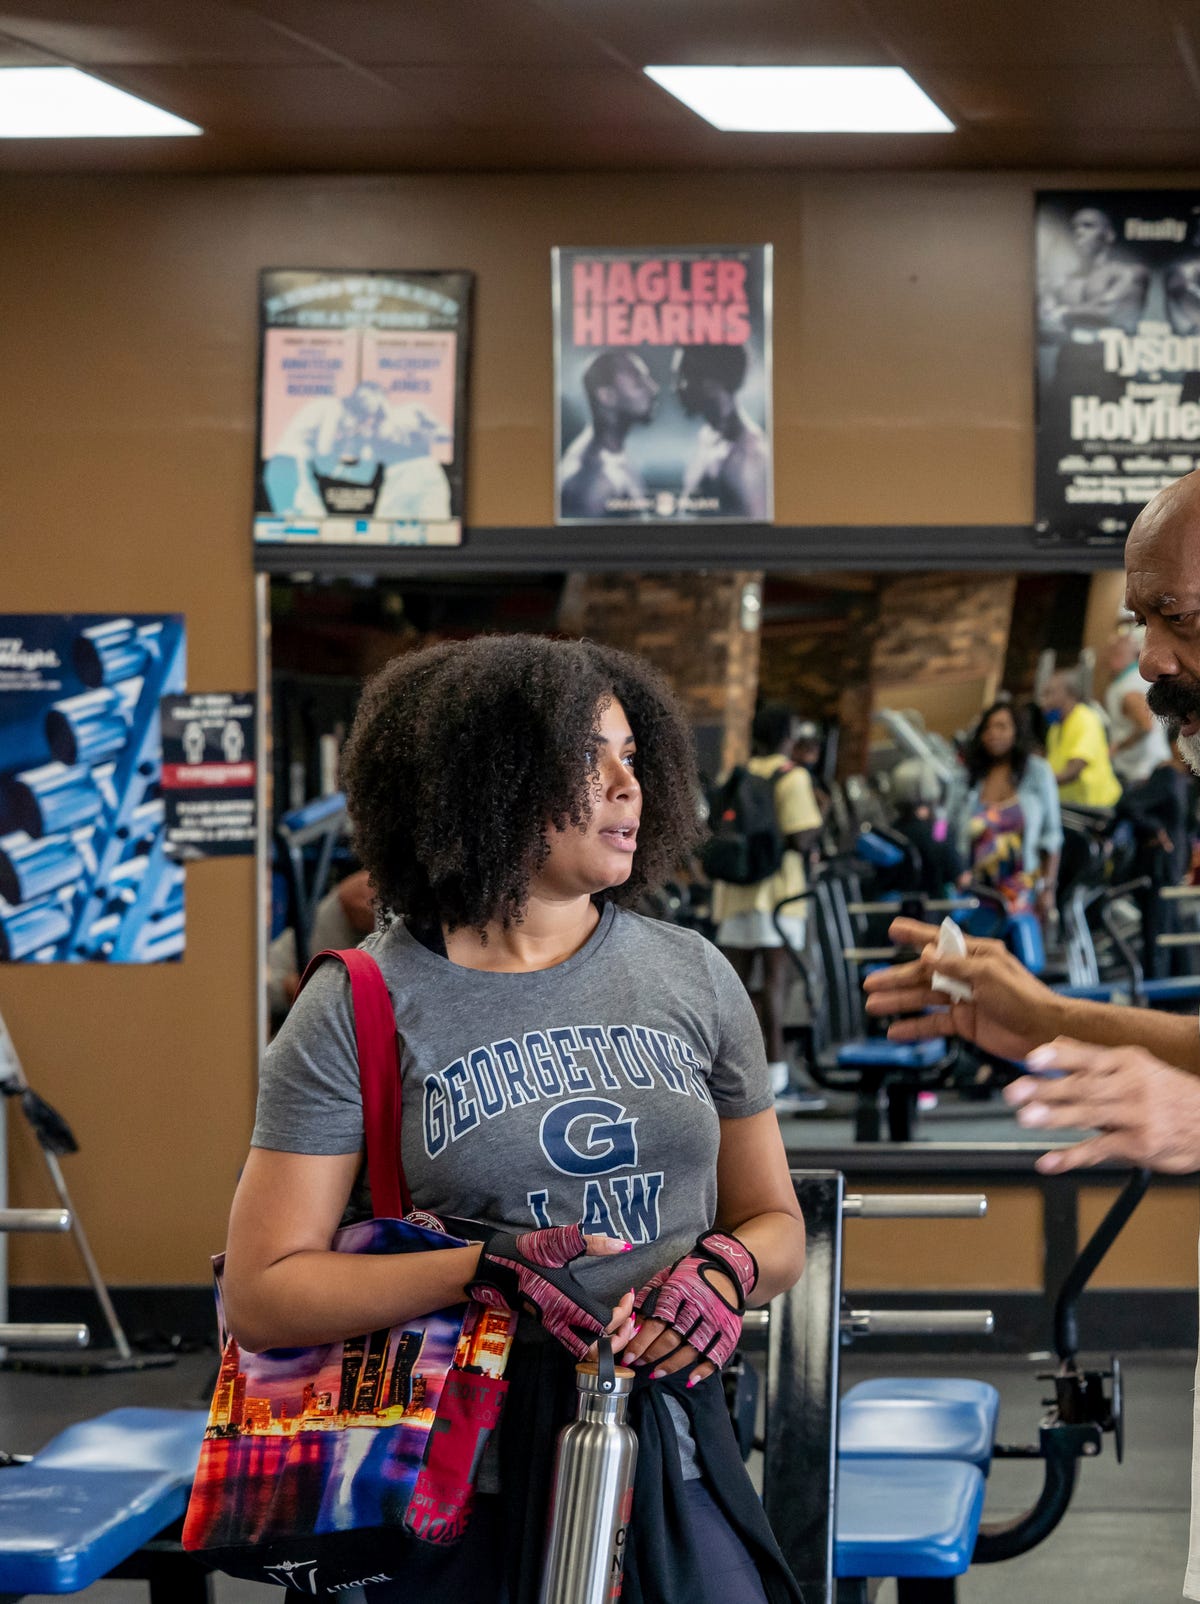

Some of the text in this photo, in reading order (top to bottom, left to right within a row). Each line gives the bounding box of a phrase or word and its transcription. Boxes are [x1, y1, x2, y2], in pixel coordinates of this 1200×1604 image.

[573, 260, 748, 304] HAGLER
[573, 303, 751, 346] HEARNS
[422, 1024, 717, 1160] GEORGETOWN
[539, 1097, 639, 1177] G
